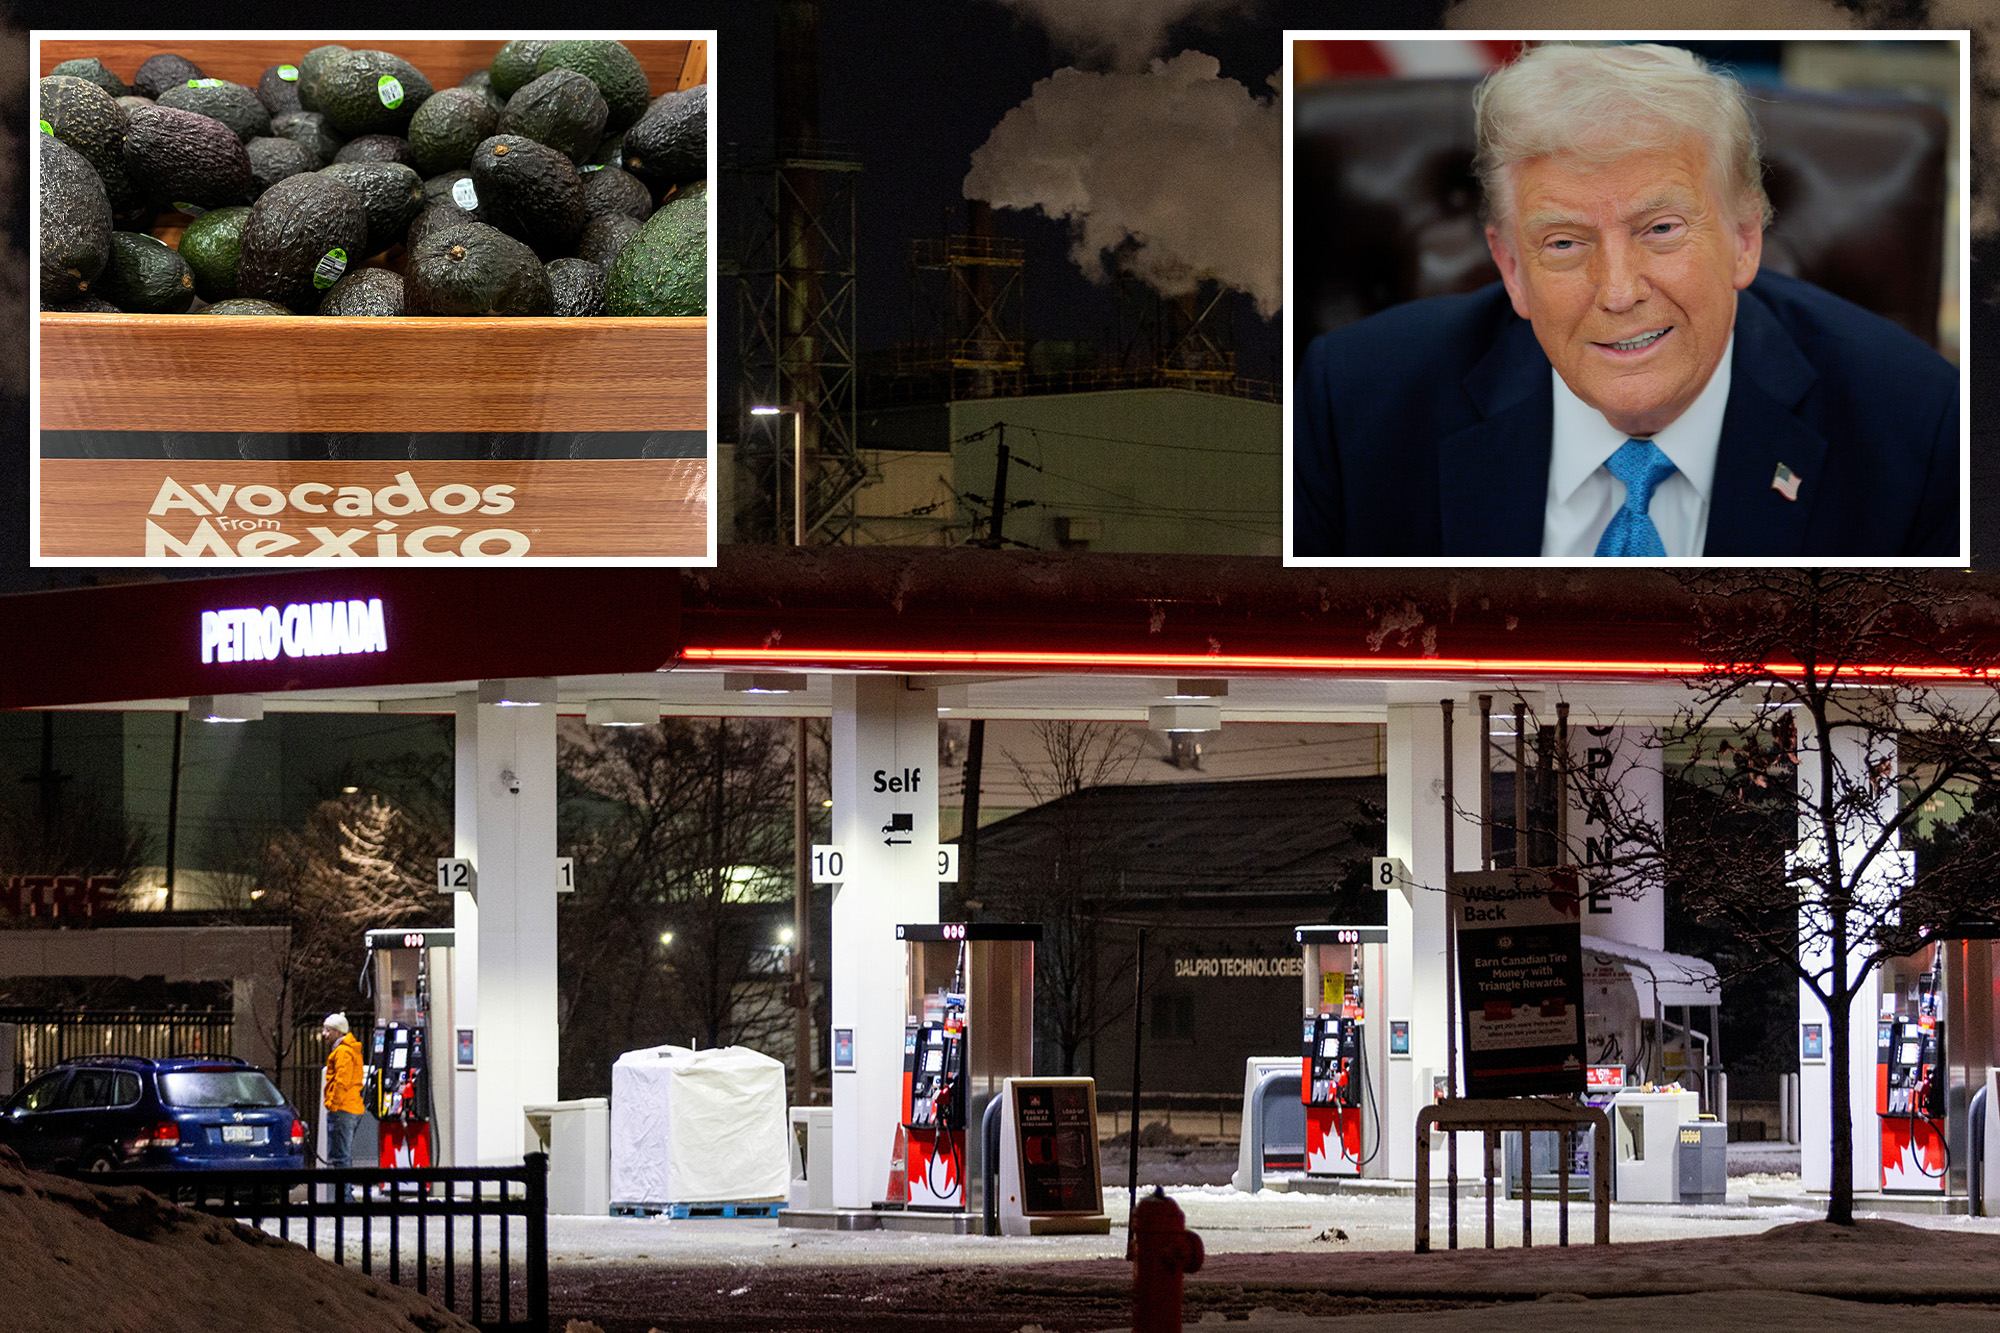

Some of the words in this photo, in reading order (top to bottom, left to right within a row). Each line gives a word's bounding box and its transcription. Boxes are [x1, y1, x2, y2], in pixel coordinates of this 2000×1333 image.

[148, 471, 516, 517] Avocados
[216, 515, 281, 532] From
[145, 517, 531, 557] Mexico
[873, 768, 921, 793] Self
[814, 851, 843, 876] 10
[938, 851, 949, 875] 9
[1380, 862, 1393, 885] 8
[439, 863, 468, 887] 12
[1464, 904, 1507, 922] Back
[1175, 958, 1219, 976] DALPRO
[1220, 958, 1303, 976] TECHNOLOGIES
[1474, 957, 1499, 968] Earn
[1501, 955, 1547, 966] Canadian
[1549, 953, 1568, 963] Tire
[1531, 966, 1553, 976] with
[1479, 980, 1521, 992] Triangle
[1523, 977, 1567, 989] Rewards.
